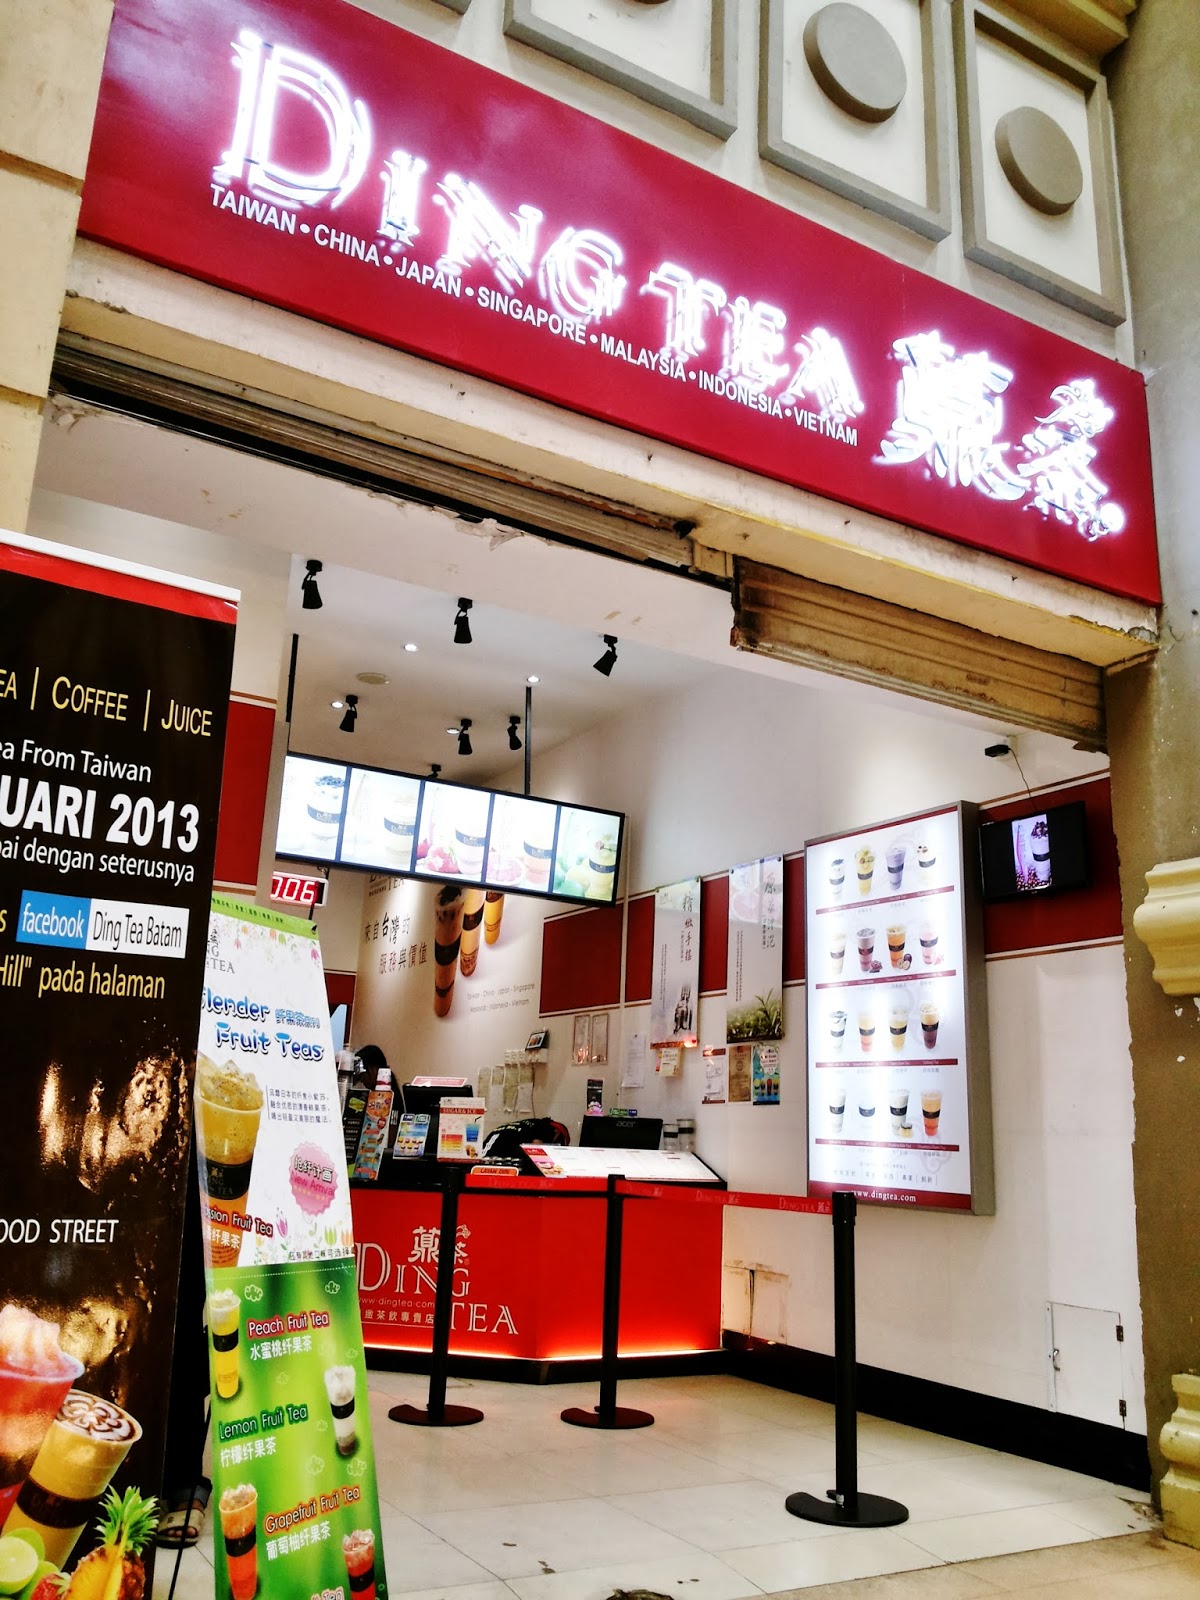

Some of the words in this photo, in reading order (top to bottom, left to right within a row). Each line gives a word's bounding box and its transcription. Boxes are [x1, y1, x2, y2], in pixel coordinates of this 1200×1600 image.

[212, 28, 626, 324] DING
[640, 260, 867, 422] TEA
[210, 184, 296, 235] TAIWAN
[313, 223, 380, 267] CHINA
[395, 255, 462, 298] JAPAN
[476, 286, 587, 345] SINGAPORE
[599, 332, 686, 382] MALAYSIA
[698, 369, 783, 418] INDONESIA
[793, 409, 858, 447] VIETNAM
[52, 676, 129, 722] COFFEE
[161, 699, 214, 737] JUICE
[21, 739, 75, 772] From
[81, 750, 152, 783] Taiwan
[106, 793, 200, 854] 2013
[23, 837, 94, 874] dengan
[99, 851, 195, 887] seterusnya
[22, 903, 86, 939] facebook
[93, 911, 121, 950] Ding
[123, 914, 144, 945] Tea
[147, 916, 182, 949] Batam
[39, 960, 86, 999] pada
[90, 964, 165, 999] halaman
[210, 958, 236, 974] TEA
[215, 1021, 271, 1055] Fruit
[275, 1032, 325, 1062] Teas
[616, 1120, 636, 1128] acer
[291, 1171, 307, 1187] New
[49, 1218, 119, 1243] STREET
[232, 1213, 252, 1229] Fruit
[256, 1218, 273, 1235] Tea
[361, 1297, 435, 1309] ww.dingtea.com
[450, 1302, 519, 1335] TEA
[248, 1319, 283, 1337] Peach
[287, 1313, 308, 1331] Fruit
[310, 1311, 330, 1327] Tea
[250, 1335, 312, 1361] 水蜜桃纤果茶
[219, 1418, 258, 1441] Lemon
[261, 1409, 284, 1429] Fruit
[286, 1405, 308, 1421] Tea
[220, 1437, 277, 1468] 柠檬纤果茶
[265, 1499, 318, 1534] Grapefruit
[320, 1491, 340, 1511] Fruit
[342, 1486, 361, 1502] Tea
